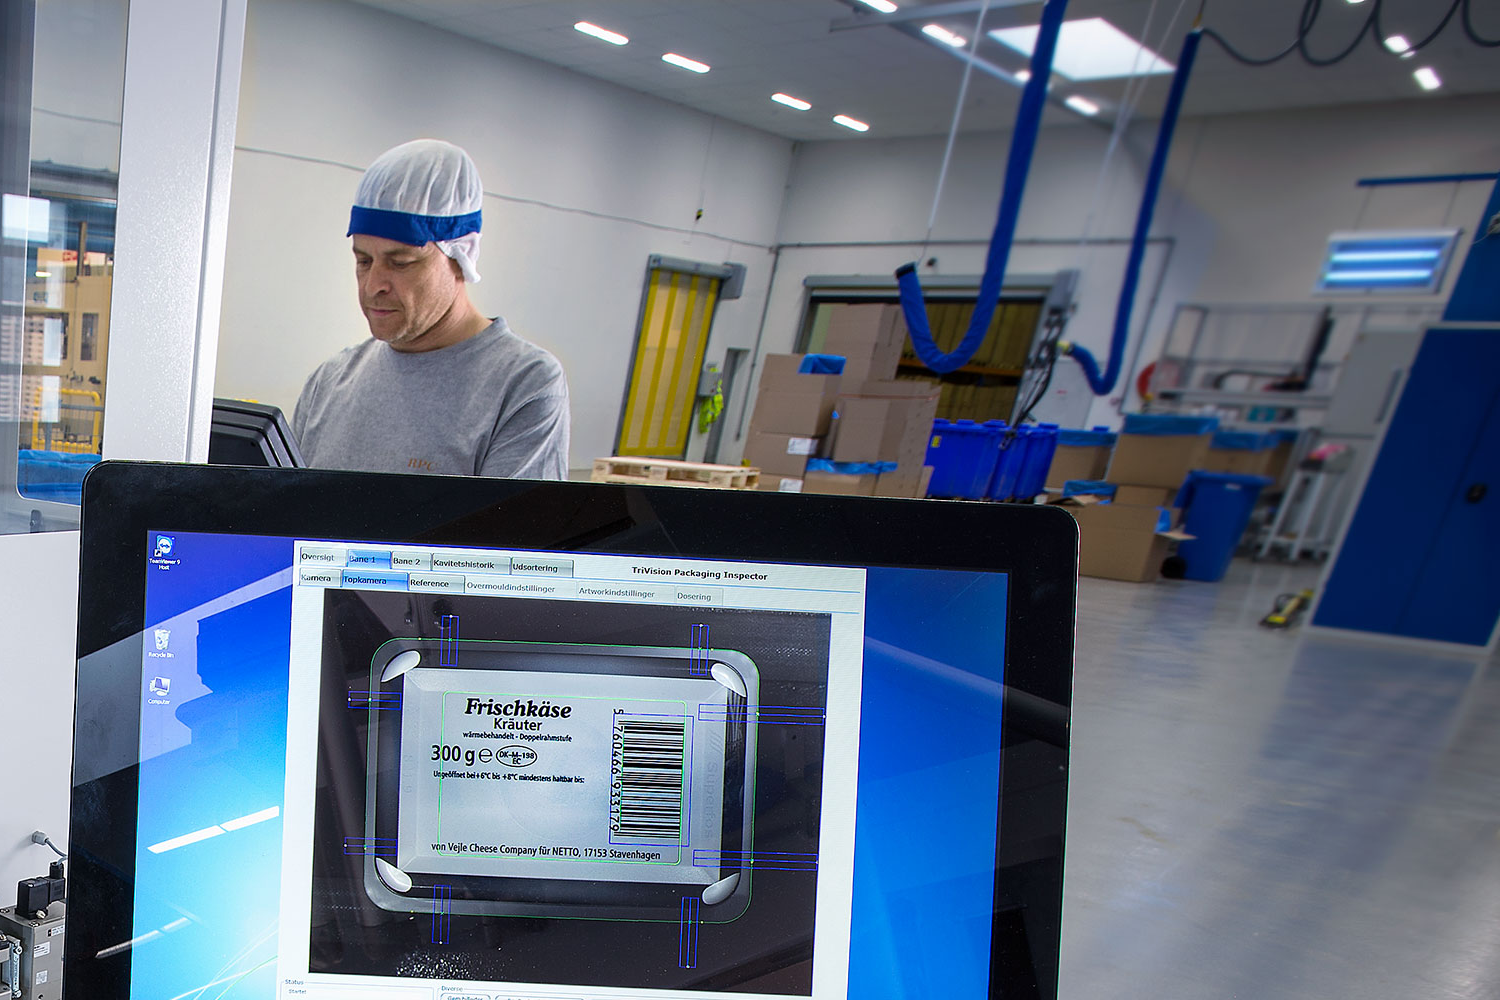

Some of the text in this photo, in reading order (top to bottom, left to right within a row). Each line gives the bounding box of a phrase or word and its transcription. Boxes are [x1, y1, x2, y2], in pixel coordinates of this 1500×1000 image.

[301, 552, 334, 562] Oversigt
[349, 555, 369, 564] Bane
[393, 557, 420, 566] Bane 2
[433, 558, 495, 570] Kavitetshistorik
[512, 563, 558, 574] Udsortering
[301, 574, 331, 583] Kamera
[632, 566, 768, 582] TriVision Packaging Inspector
[344, 576, 387, 586] Topkamera
[410, 579, 449, 588] Reference
[466, 582, 556, 594] Overmouldindstillinger
[578, 587, 655, 599] Artworkindstillinger
[677, 592, 712, 602] Dosering
[464, 698, 572, 718] Frischkäse
[494, 718, 542, 731] Kräuter
[463, 731, 514, 740] wärmebehandelt
[519, 732, 572, 742] Doppelrahmstufe
[431, 745, 462, 762] 300
[464, 750, 476, 766] g
[611, 725, 624, 775] 760466
[518, 774, 552, 782] mindestens
[609, 782, 622, 832] 933179
[448, 842, 468, 854] Vejle
[470, 844, 498, 853] Cheese
[499, 845, 537, 857] Company
[538, 846, 550, 856] für
[552, 847, 581, 858] NETTO,
[584, 848, 607, 858] 17153
[610, 848, 661, 862] Stavenhagen
